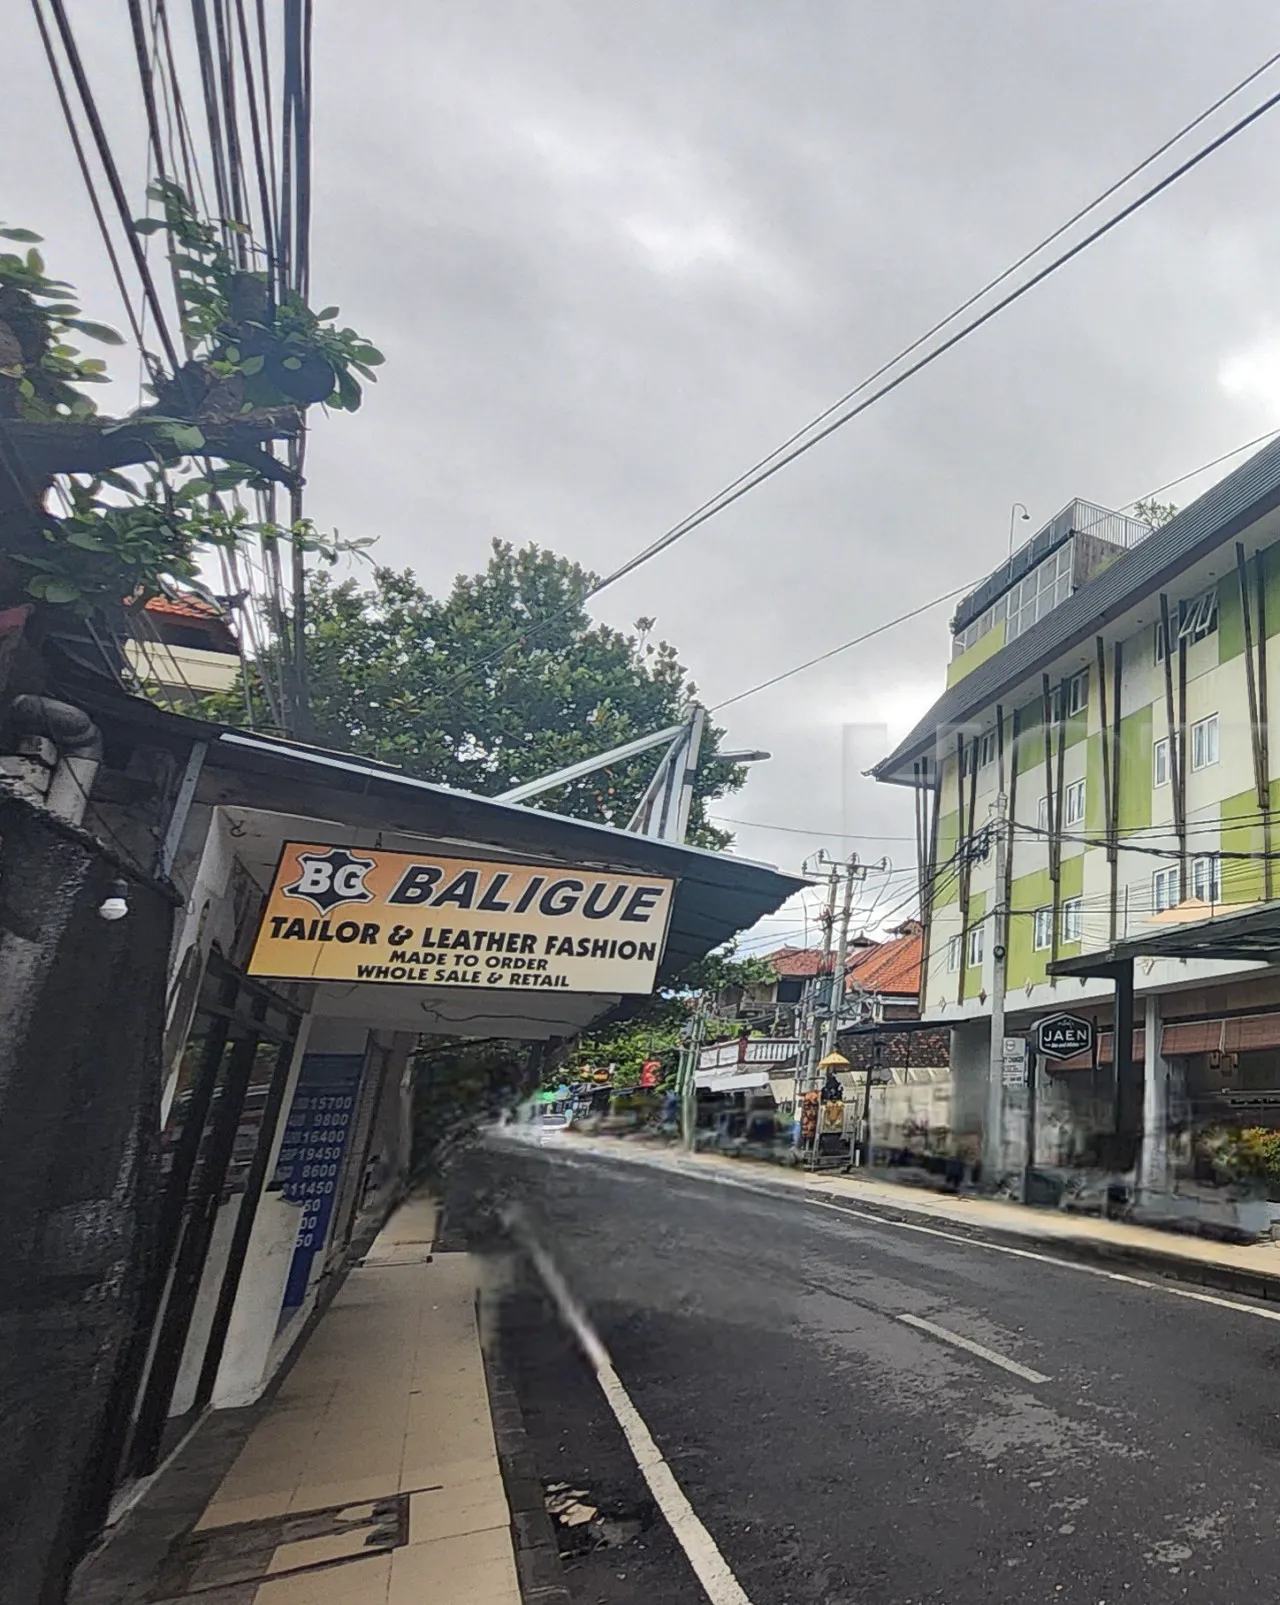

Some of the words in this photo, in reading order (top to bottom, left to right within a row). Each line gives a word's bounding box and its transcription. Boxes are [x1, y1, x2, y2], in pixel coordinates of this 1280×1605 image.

[298, 860, 368, 897] BG
[386, 864, 665, 922] BALIGUE
[270, 916, 381, 945] TAILOR
[388, 924, 414, 946] &
[421, 926, 538, 954] LEATHER
[545, 935, 657, 961] FASHION
[388, 950, 448, 966] MADE
[453, 953, 480, 967] TO
[485, 955, 549, 971] ORDER
[356, 964, 429, 981] WHOLE
[433, 968, 482, 984] SALE
[486, 971, 503, 984] &
[508, 972, 570, 987] RETAIL
[1043, 1029, 1087, 1042] JAEN
[310, 1096, 353, 1110] 15700
[312, 1113, 349, 1127] 9800
[302, 1130, 345, 1144] 16400
[298, 1146, 341, 1161] 19450
[301, 1164, 337, 1178] 8600
